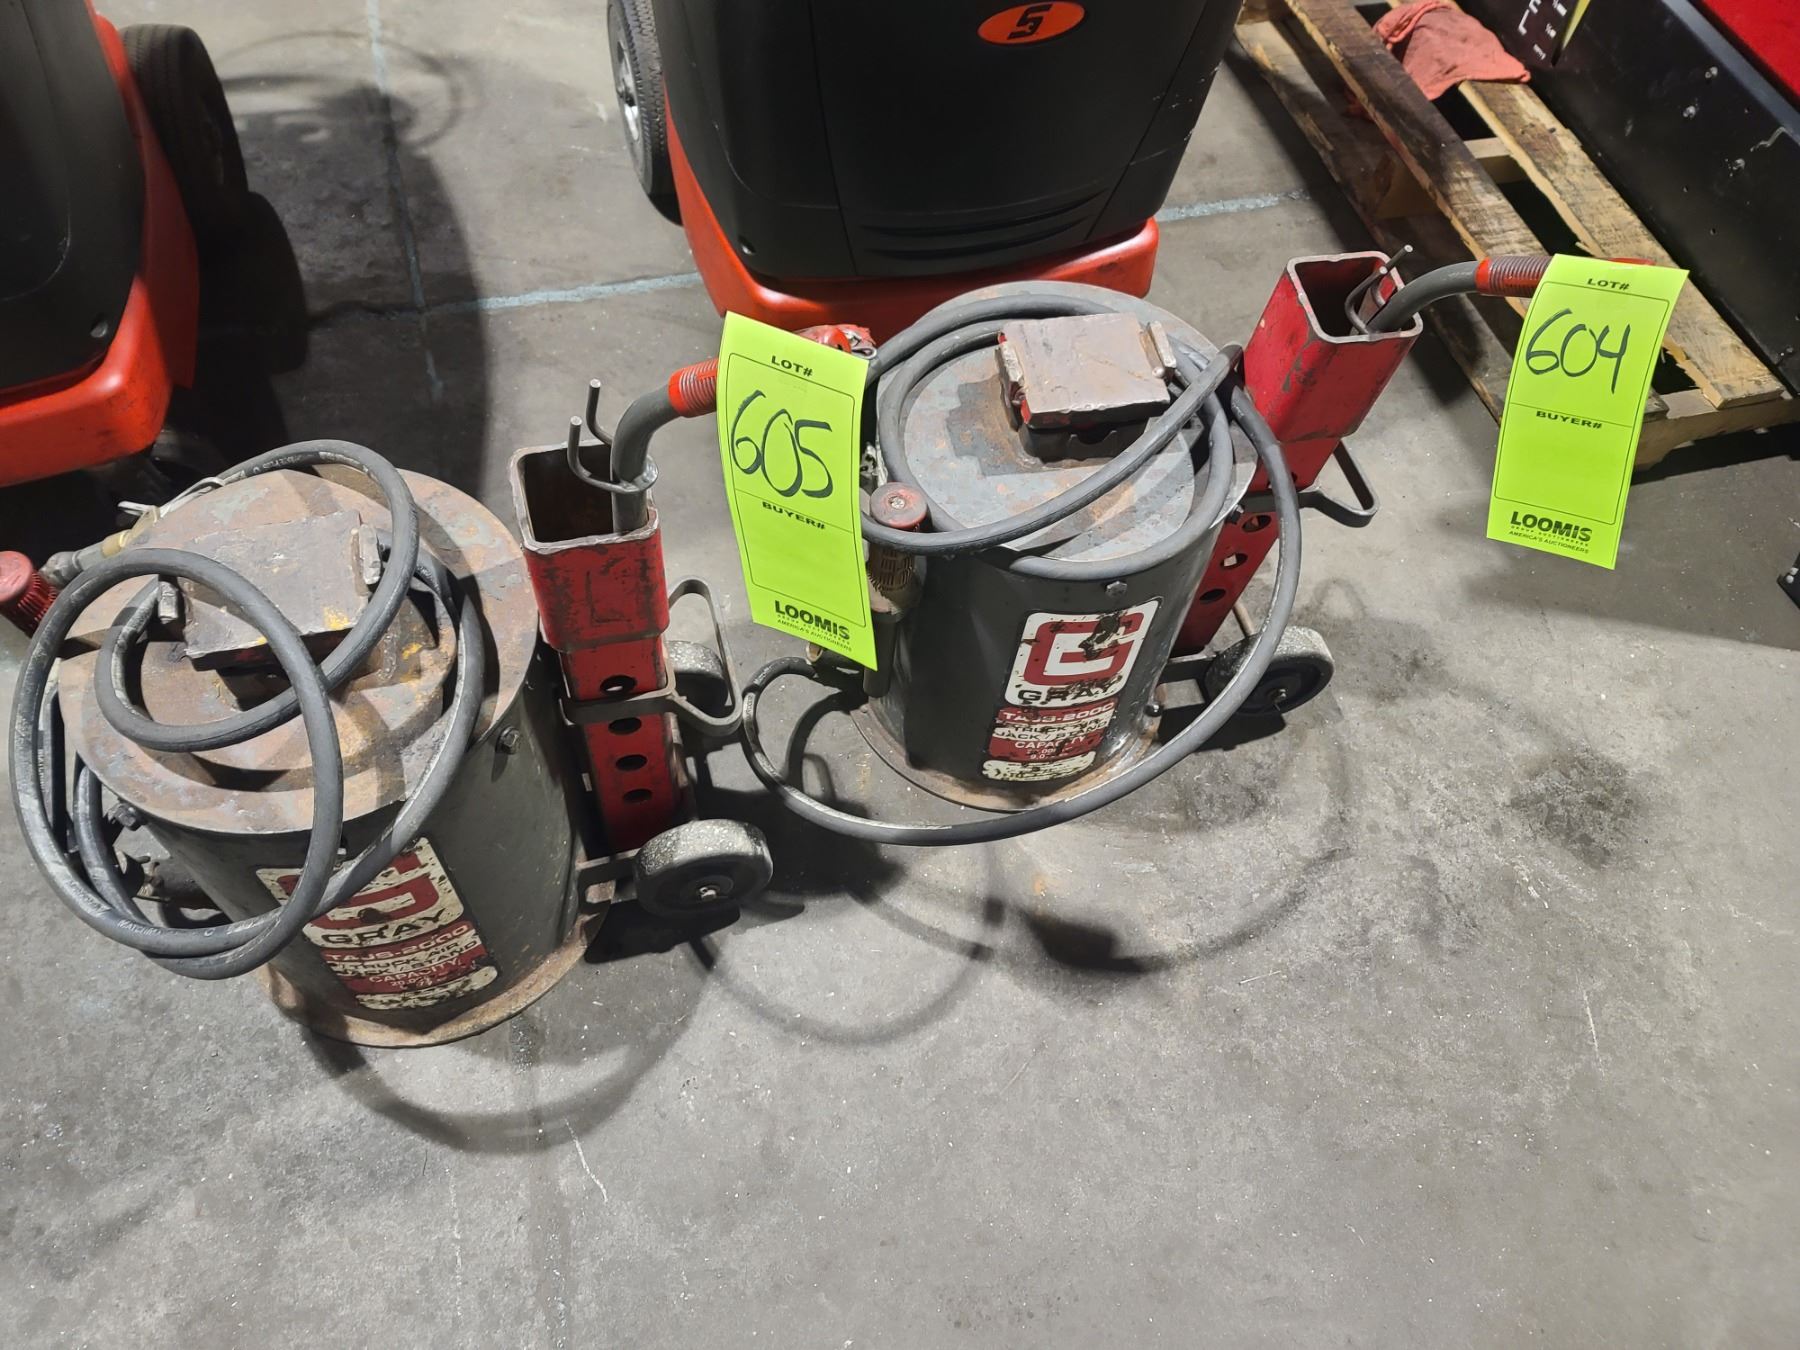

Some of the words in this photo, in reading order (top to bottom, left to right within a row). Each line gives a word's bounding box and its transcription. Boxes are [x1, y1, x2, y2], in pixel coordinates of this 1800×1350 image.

[1587, 278, 1631, 290] LOT#
[771, 355, 814, 377] LOT#
[1525, 308, 1631, 394] 604
[1535, 410, 1603, 429] BUYER#
[731, 389, 834, 498] 605
[762, 501, 826, 530] BUYER#
[1510, 511, 1593, 542] LOOMIS
[774, 600, 851, 640] LOOMIS
[321, 908, 447, 944] GRAY
[427, 942, 460, 960] AIR
